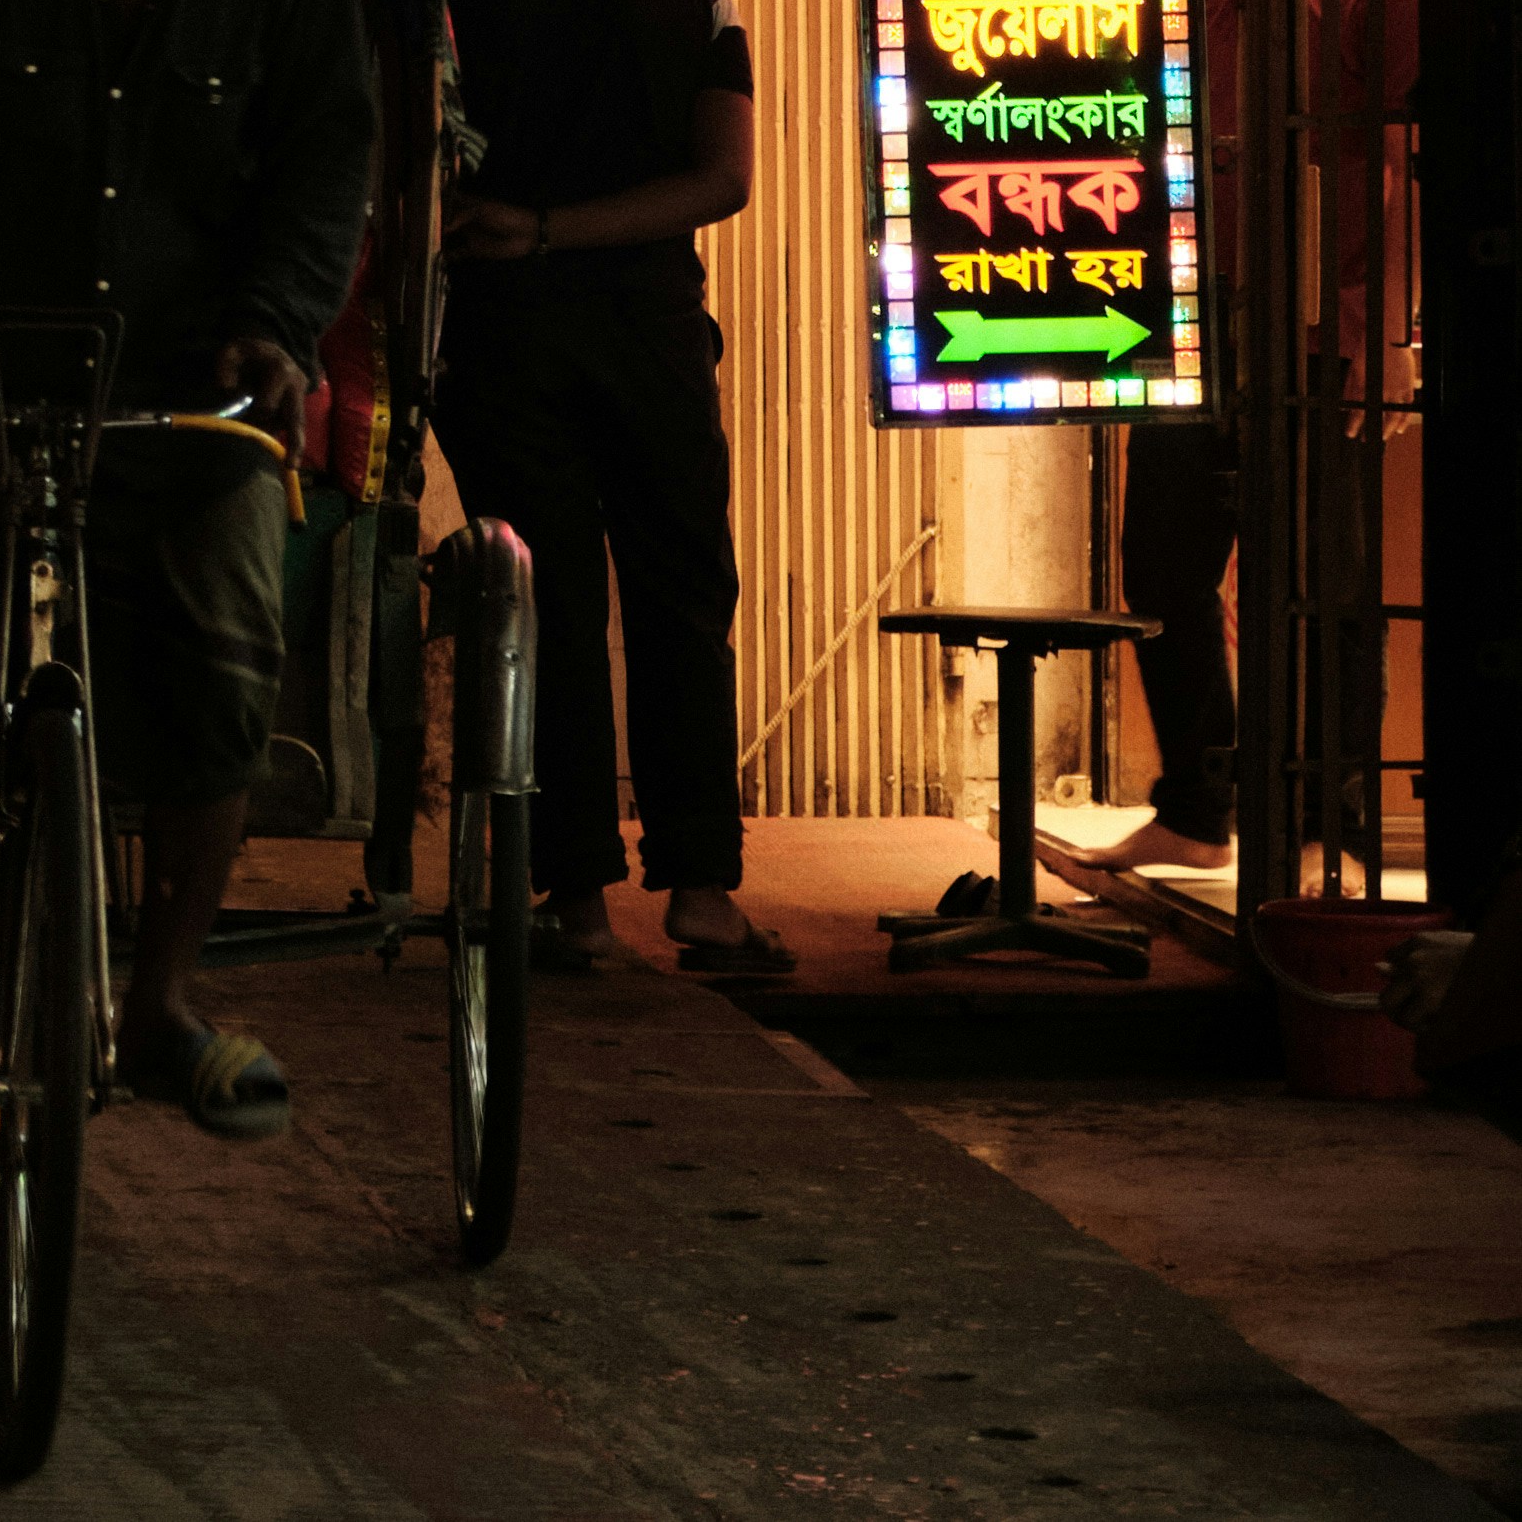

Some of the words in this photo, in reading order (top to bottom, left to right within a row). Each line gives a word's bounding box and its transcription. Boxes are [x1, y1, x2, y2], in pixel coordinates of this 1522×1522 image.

[925, 81, 1149, 144] স্বর্ণালংকার
[927, 157, 1145, 237] বন্ধক
[934, 246, 1054, 294] রাখা
[1064, 248, 1147, 297] হয়
